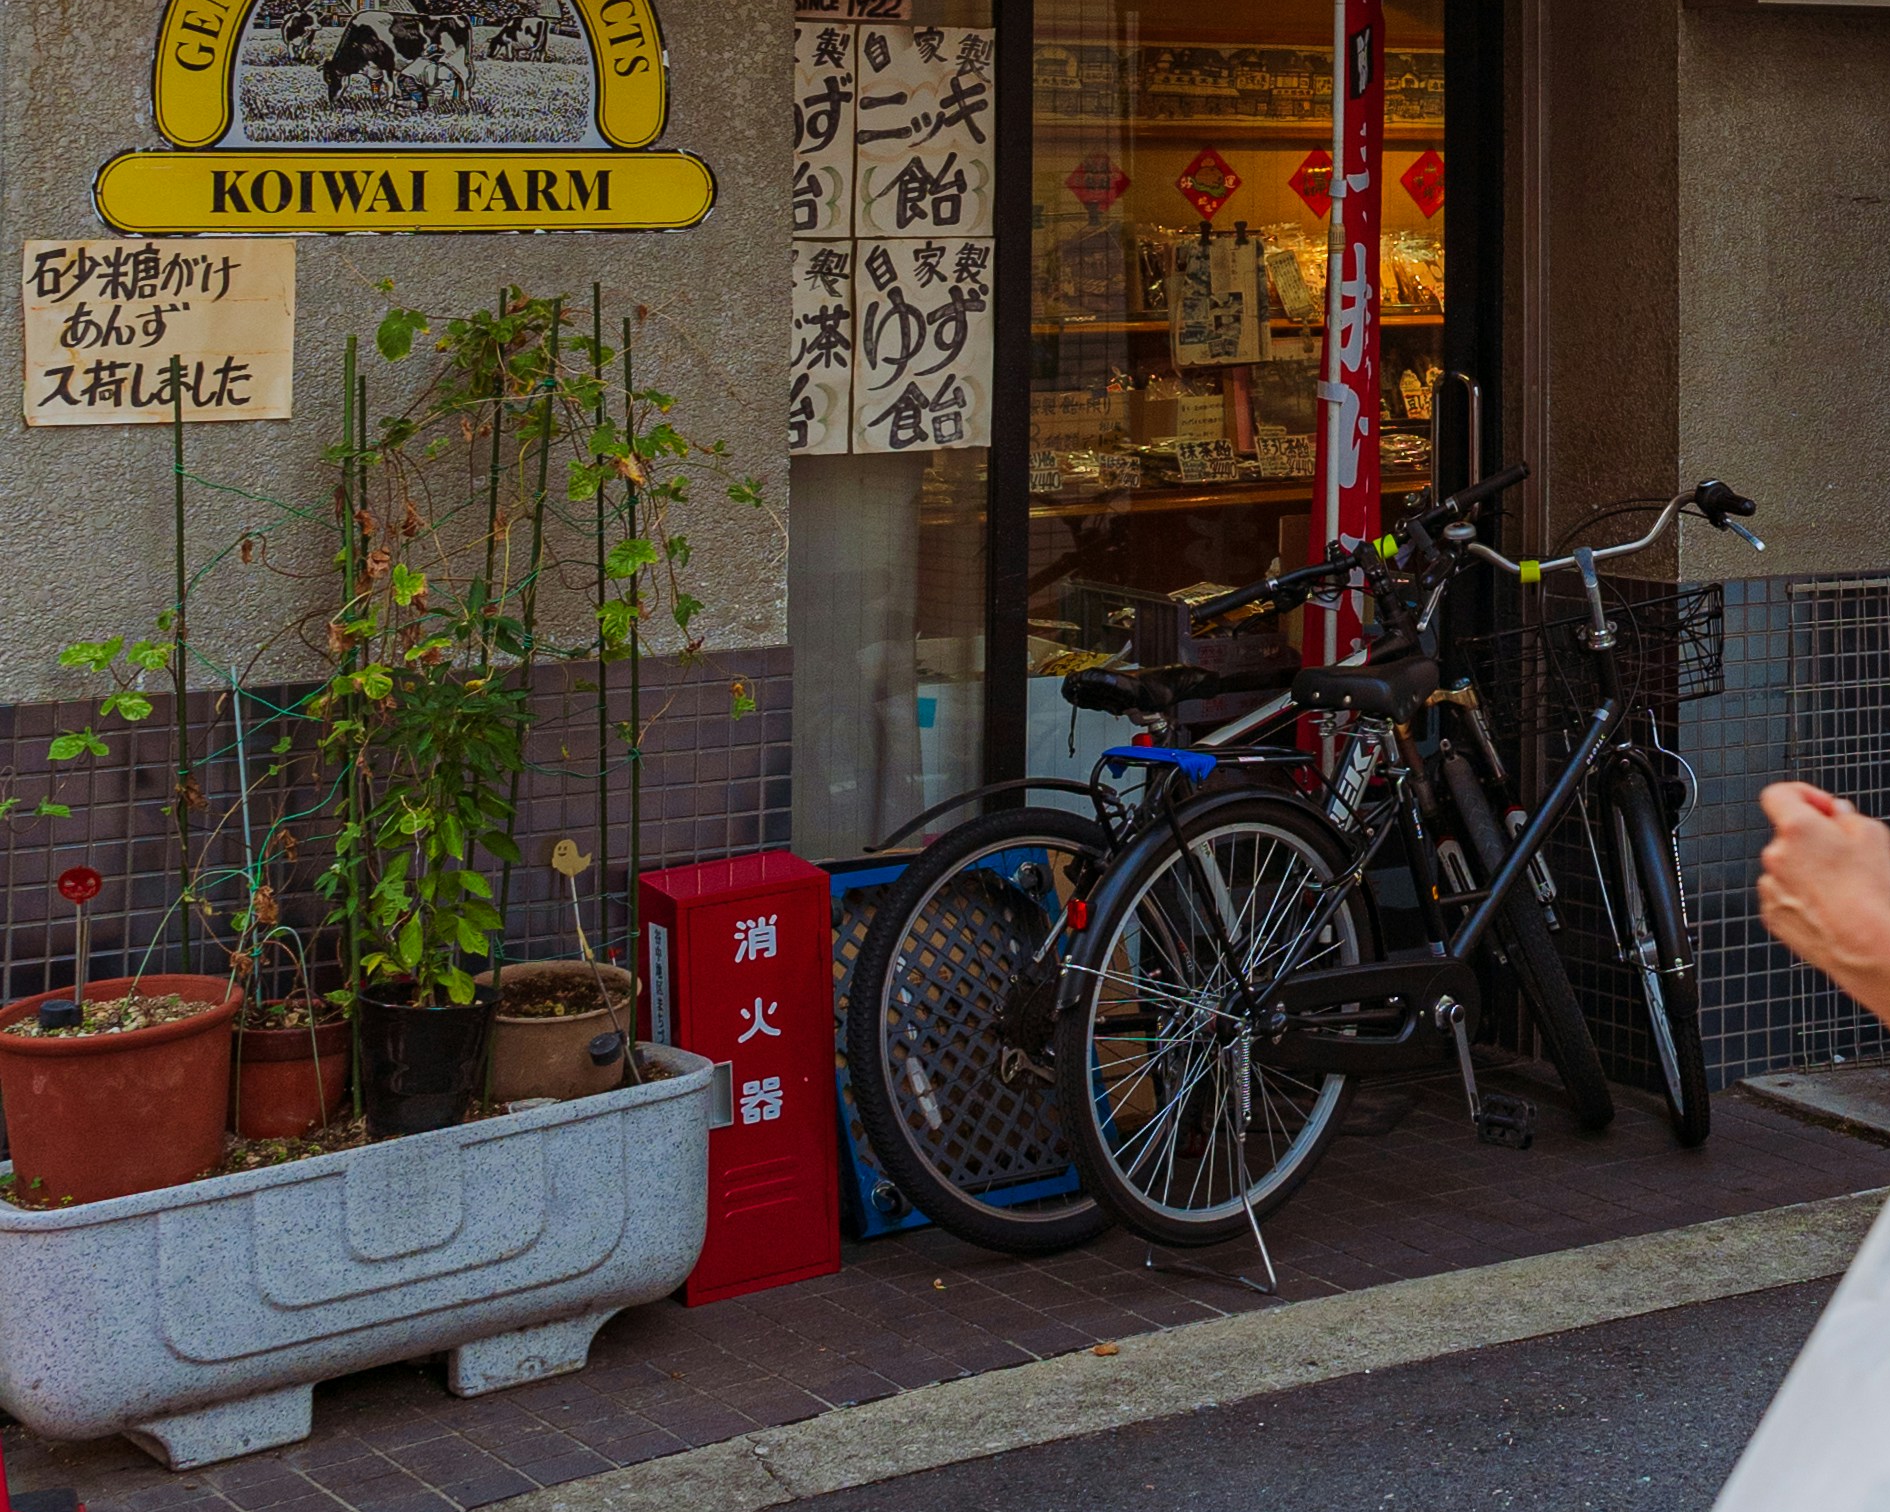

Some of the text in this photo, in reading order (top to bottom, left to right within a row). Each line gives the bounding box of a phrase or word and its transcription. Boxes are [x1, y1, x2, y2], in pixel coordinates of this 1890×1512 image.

[864, 26, 994, 83] 自家製
[857, 76, 988, 146] ニッキ
[209, 168, 613, 214] KOIWAI FARM
[875, 152, 967, 230] 飴
[26, 241, 241, 304] 砂糖がけ
[864, 242, 989, 292] 自家製
[59, 301, 190, 348] あんず
[864, 283, 988, 391] ゆず
[867, 374, 967, 449] 飴
[1179, 439, 1232, 461] 抹茶飴
[734, 913, 783, 1125] 消火器
